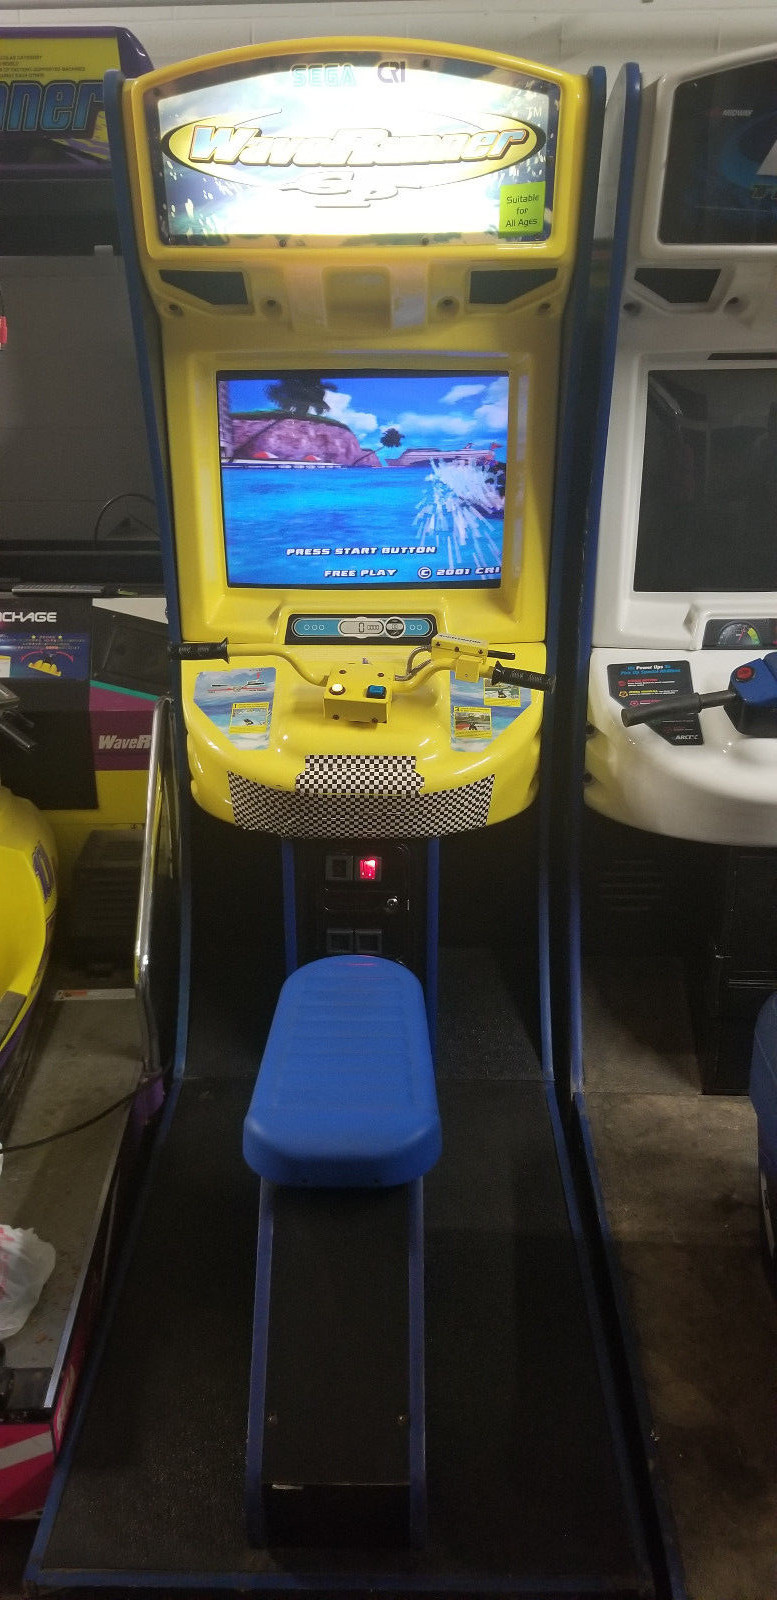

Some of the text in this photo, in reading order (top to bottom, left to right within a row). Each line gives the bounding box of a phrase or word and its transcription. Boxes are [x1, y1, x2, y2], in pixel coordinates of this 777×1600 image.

[290, 63, 357, 88] SEGA
[377, 61, 407, 84] CRI
[0, 80, 104, 132] ner
[188, 125, 530, 168] WaveRunner
[506, 194, 540, 204] Suitable
[516, 207, 529, 215] for
[505, 219, 538, 228] All Ages
[286, 546, 436, 556] PRESS START BUTTON
[323, 569, 398, 578] FREE PLAY
[474, 566, 501, 575] CRI
[0, 611, 57, 623] CHAGE
